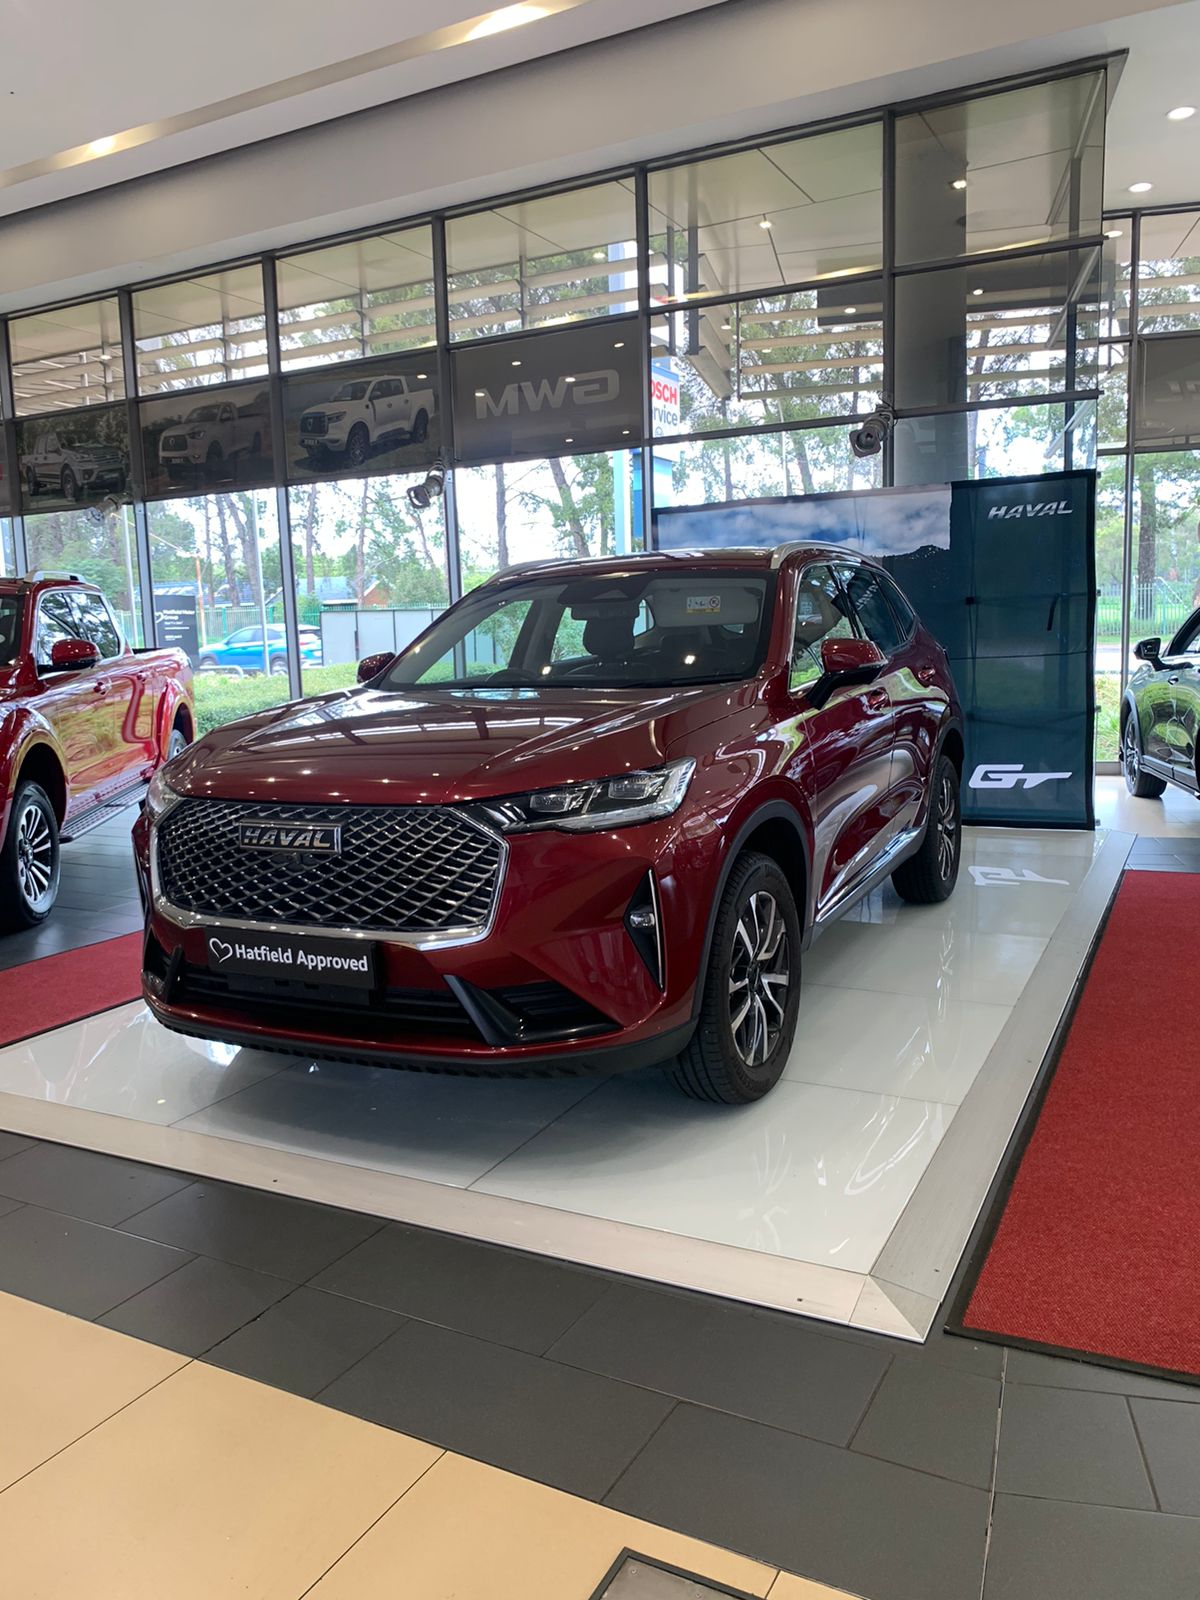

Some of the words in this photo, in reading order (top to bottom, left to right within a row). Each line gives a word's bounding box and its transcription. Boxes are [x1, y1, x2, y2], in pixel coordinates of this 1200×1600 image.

[987, 501, 1073, 520] HAVAL
[968, 764, 1072, 789] GT
[244, 828, 330, 848] HAVAL
[235, 943, 293, 964] Hatfield
[297, 950, 369, 971] Approved
